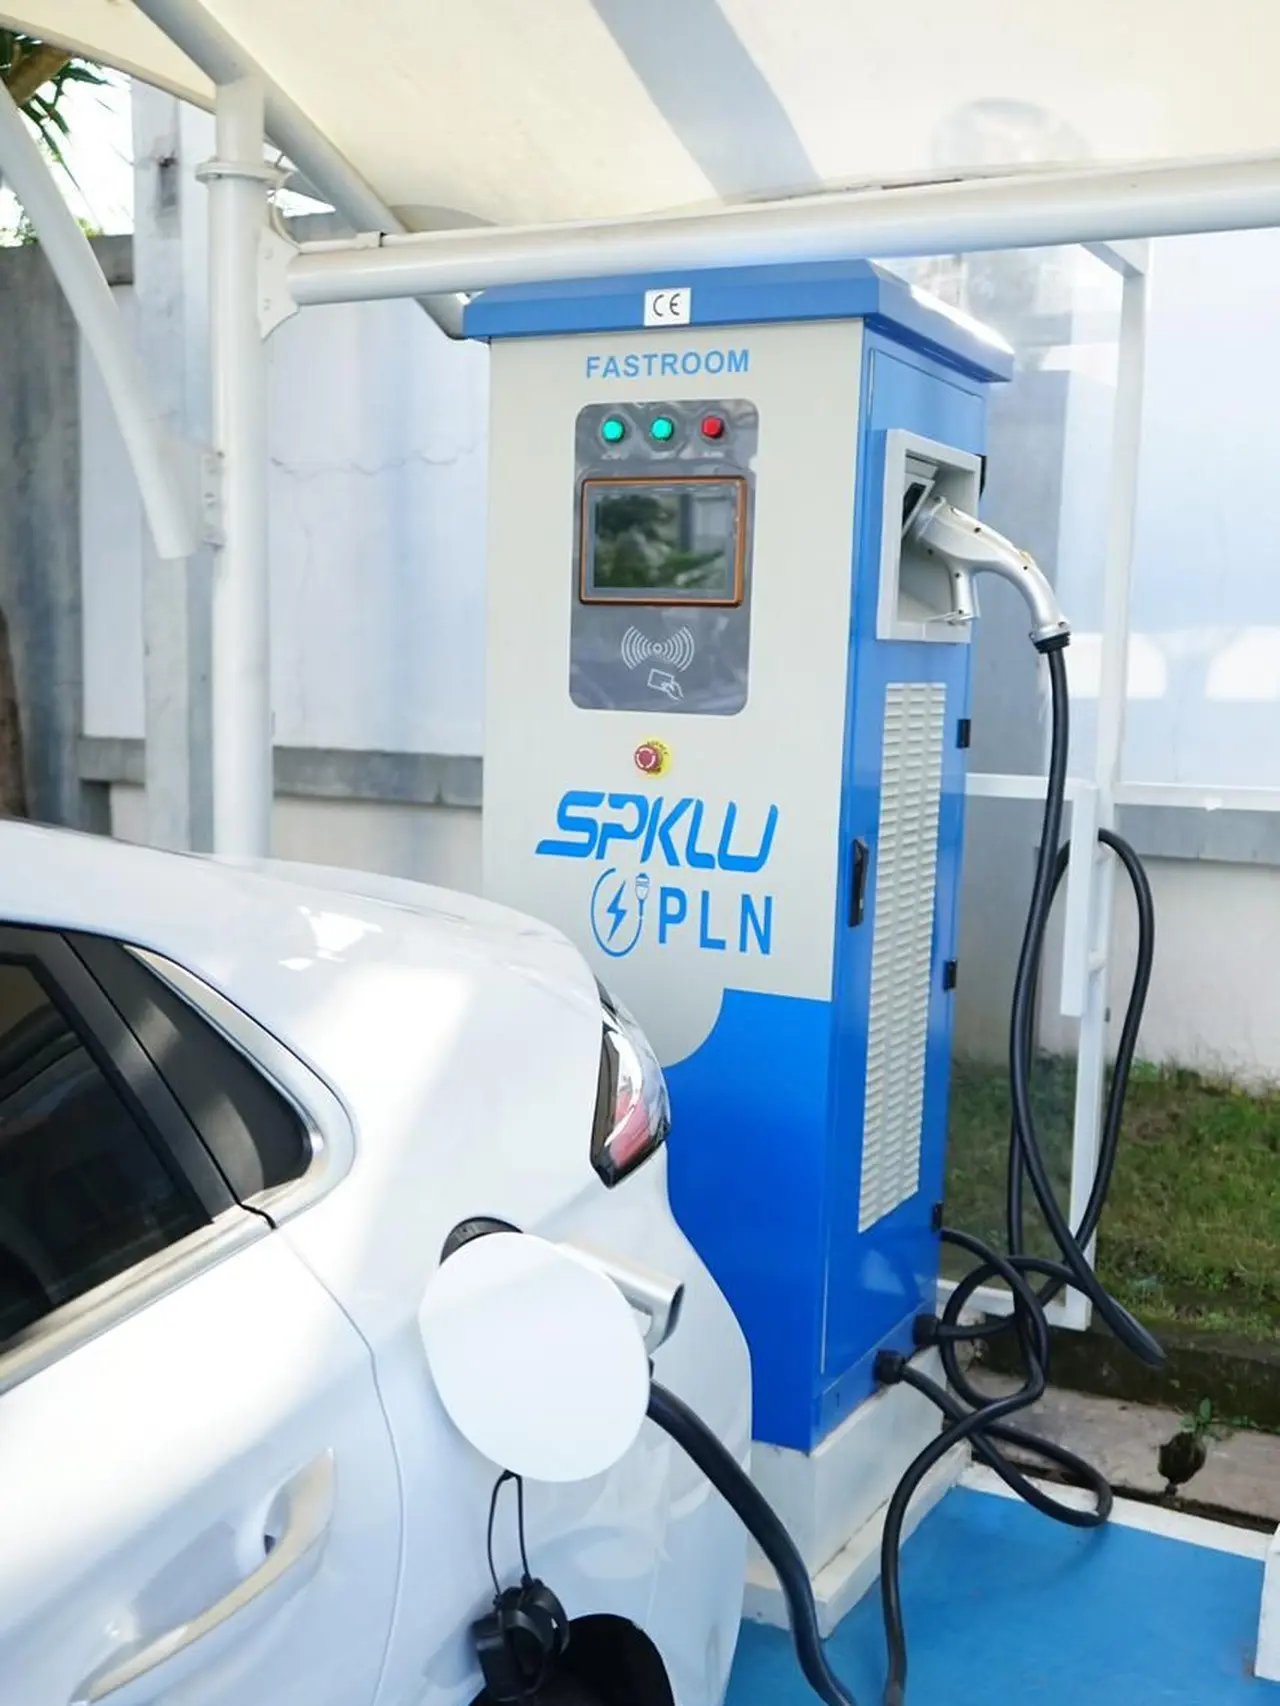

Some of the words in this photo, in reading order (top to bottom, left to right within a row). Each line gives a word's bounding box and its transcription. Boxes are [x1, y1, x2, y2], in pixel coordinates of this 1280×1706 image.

[653, 293, 681, 317] CE
[586, 349, 750, 378] FASTROOM
[535, 790, 779, 873] SPKLU
[658, 886, 773, 955] PLN
